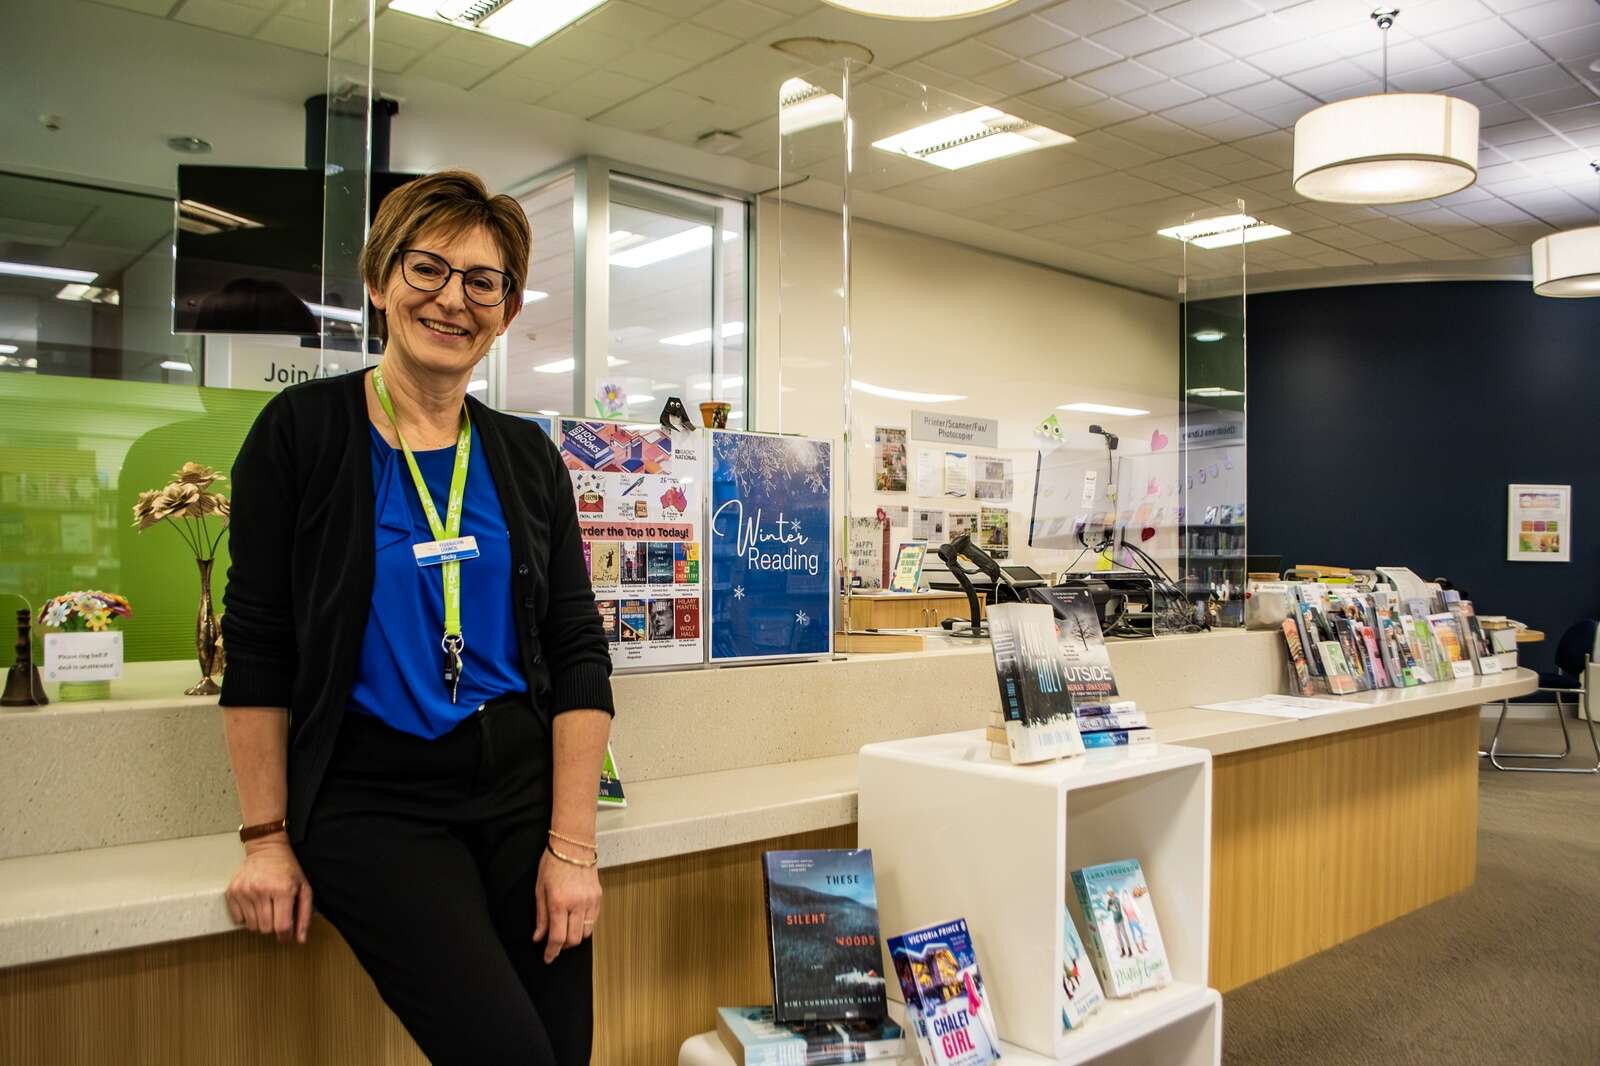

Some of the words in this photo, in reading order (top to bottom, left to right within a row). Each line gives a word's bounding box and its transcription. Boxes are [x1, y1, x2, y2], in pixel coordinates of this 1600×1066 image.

[938, 428, 974, 441] Photocopier
[574, 434, 601, 453] BOOKS
[607, 526, 624, 537] the
[625, 527, 644, 539] Top
[646, 527, 656, 537] 10
[658, 528, 689, 539] Today!
[712, 499, 809, 557] Winter
[748, 547, 819, 576] Reading
[1036, 657, 1062, 693] HOLT
[1063, 665, 1112, 682] UTSIDE
[826, 874, 859, 885] THESE
[786, 912, 827, 925] SILENT
[835, 935, 876, 946] WOODS
[908, 930, 938, 945] VICTORIA
[933, 1009, 970, 1037] CHALET
[942, 1029, 976, 1059] GIRL
